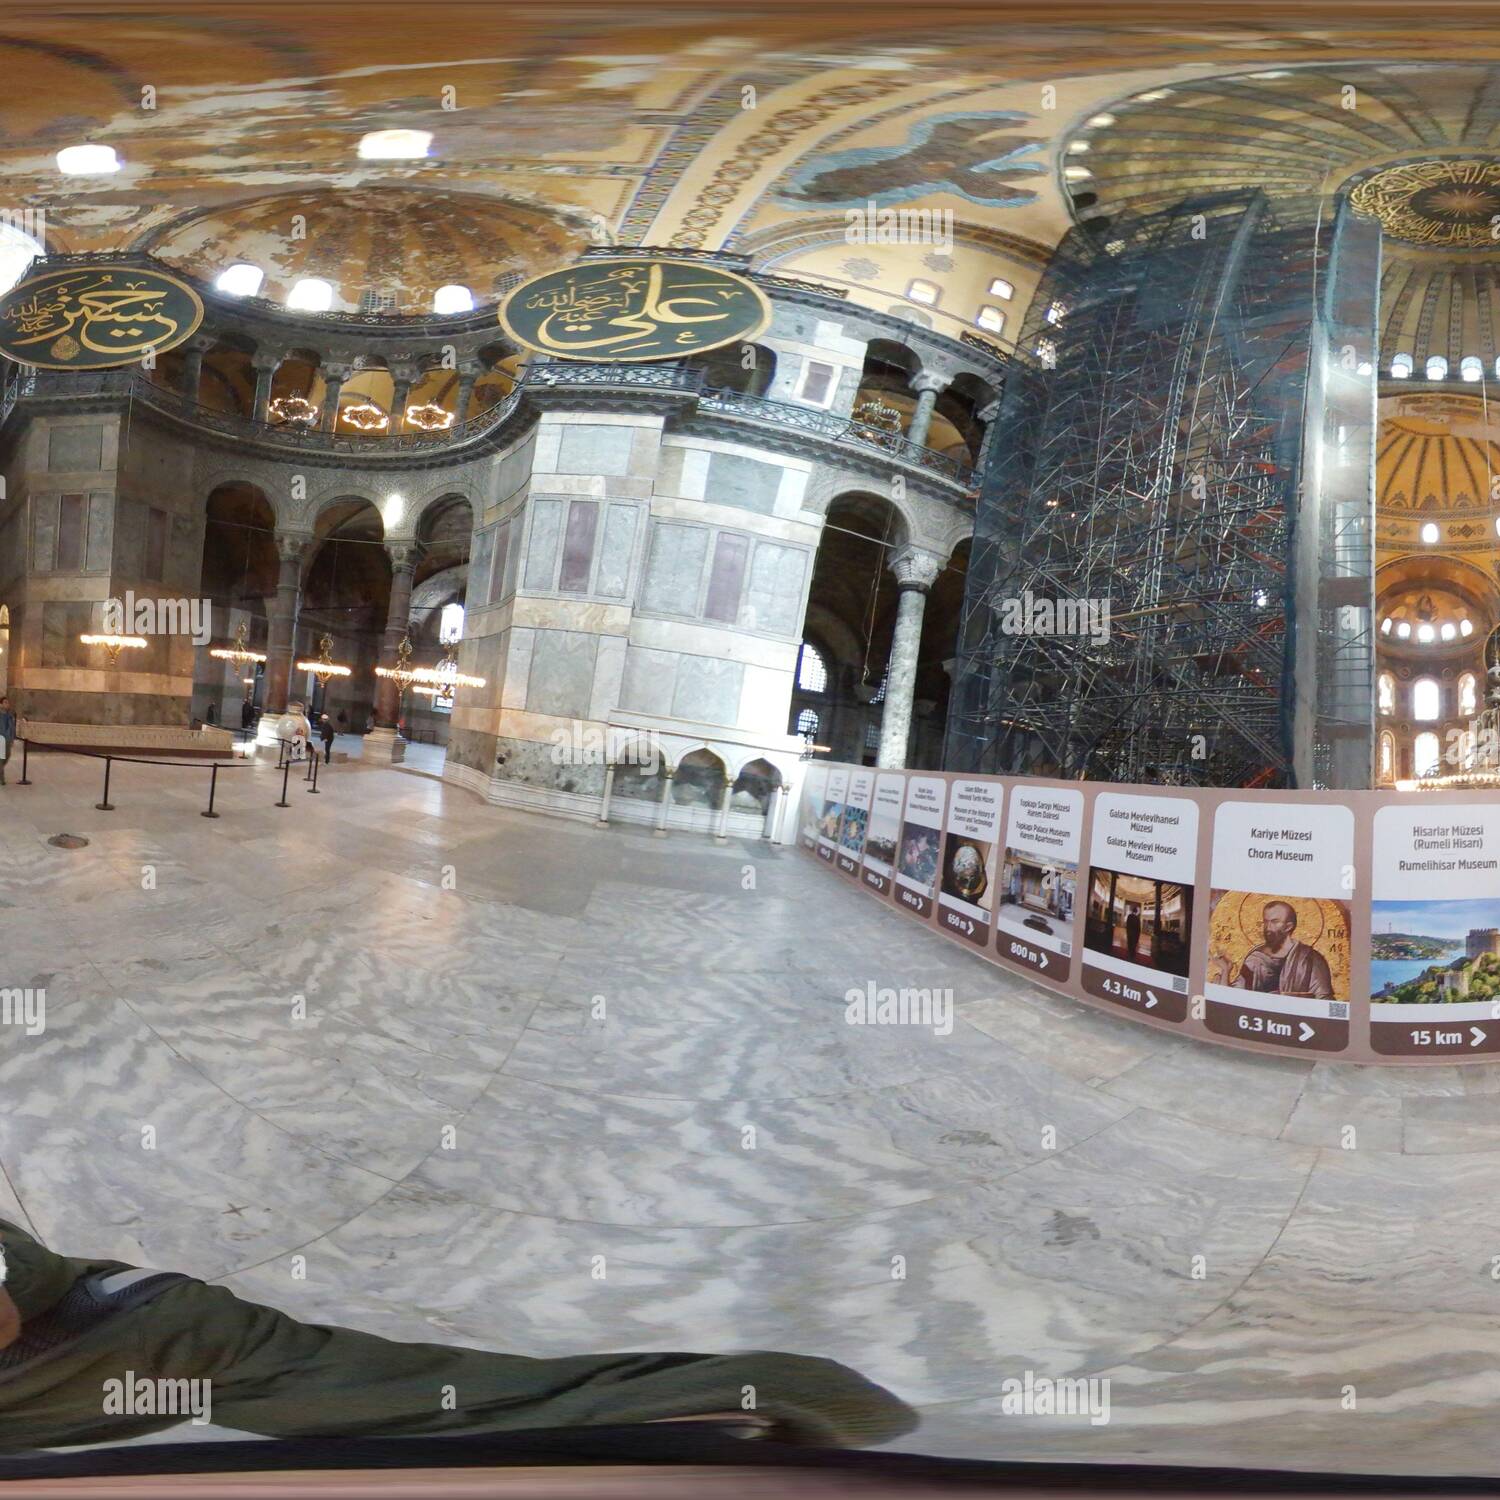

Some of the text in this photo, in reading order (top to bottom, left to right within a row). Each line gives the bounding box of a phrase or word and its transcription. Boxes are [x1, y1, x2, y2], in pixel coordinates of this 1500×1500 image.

[1109, 809, 1180, 825] Galata Mevlevihanesi
[1130, 822, 1154, 833] Müzesi
[1250, 828, 1312, 841] Kariye Müzesi
[1412, 825, 1484, 837] Hisarlar Müzesi
[1106, 836, 1178, 855] Galata Mevlevi House
[1413, 838, 1484, 850] (Rumeli Hisarı)
[1126, 849, 1154, 862] Museum
[1247, 848, 1313, 862] Chora Museum
[1399, 860, 1498, 871] Rumelihisar Museum
[1010, 941, 1037, 963] 800 m
[1102, 979, 1142, 1002] 4.3 km
[1238, 1015, 1292, 1036] 6.3 km
[1410, 1030, 1462, 1045] 15 km
